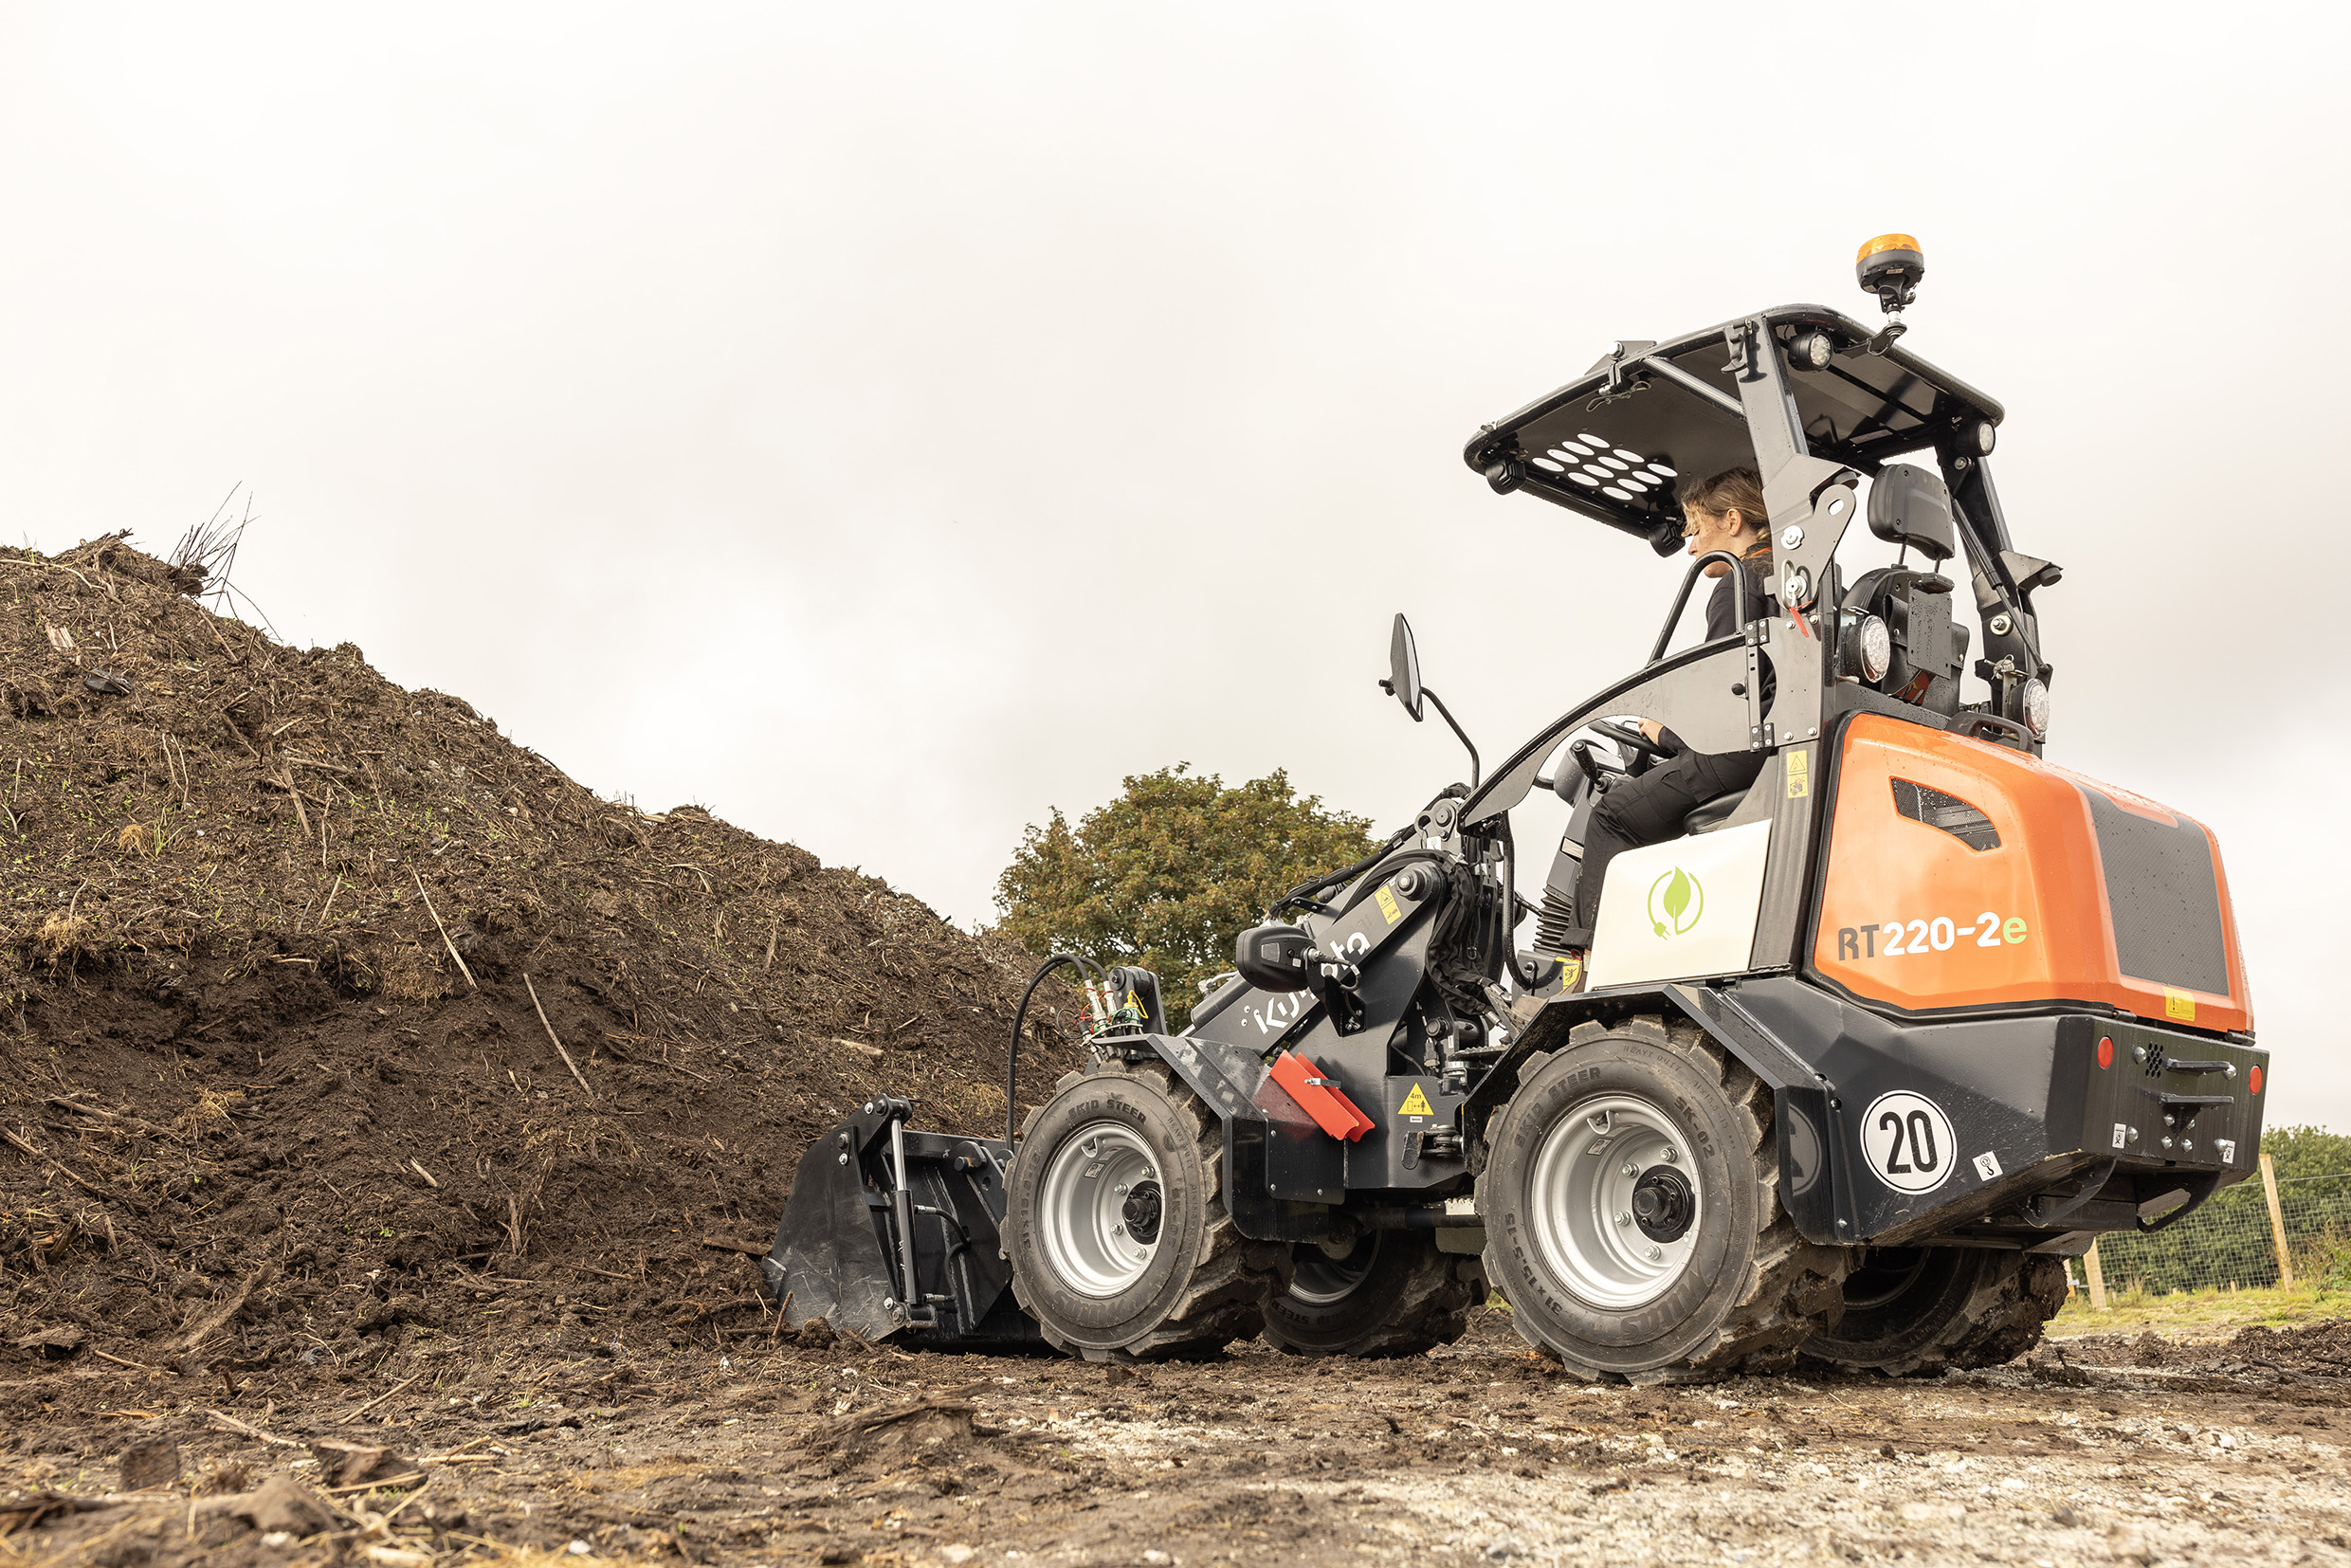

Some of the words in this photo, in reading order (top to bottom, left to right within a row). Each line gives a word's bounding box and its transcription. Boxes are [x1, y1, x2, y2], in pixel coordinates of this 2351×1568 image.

[1838, 912, 2028, 961] RT220-2e
[1068, 1100, 1100, 1119] SKID
[1106, 1099, 1147, 1125] STEER
[1515, 1103, 1543, 1148] SKID
[1548, 1067, 1601, 1100] STEER
[1673, 1096, 1715, 1159] SK-02
[1879, 1109, 1939, 1175] 20
[1620, 1254, 1709, 1340] Mitas
